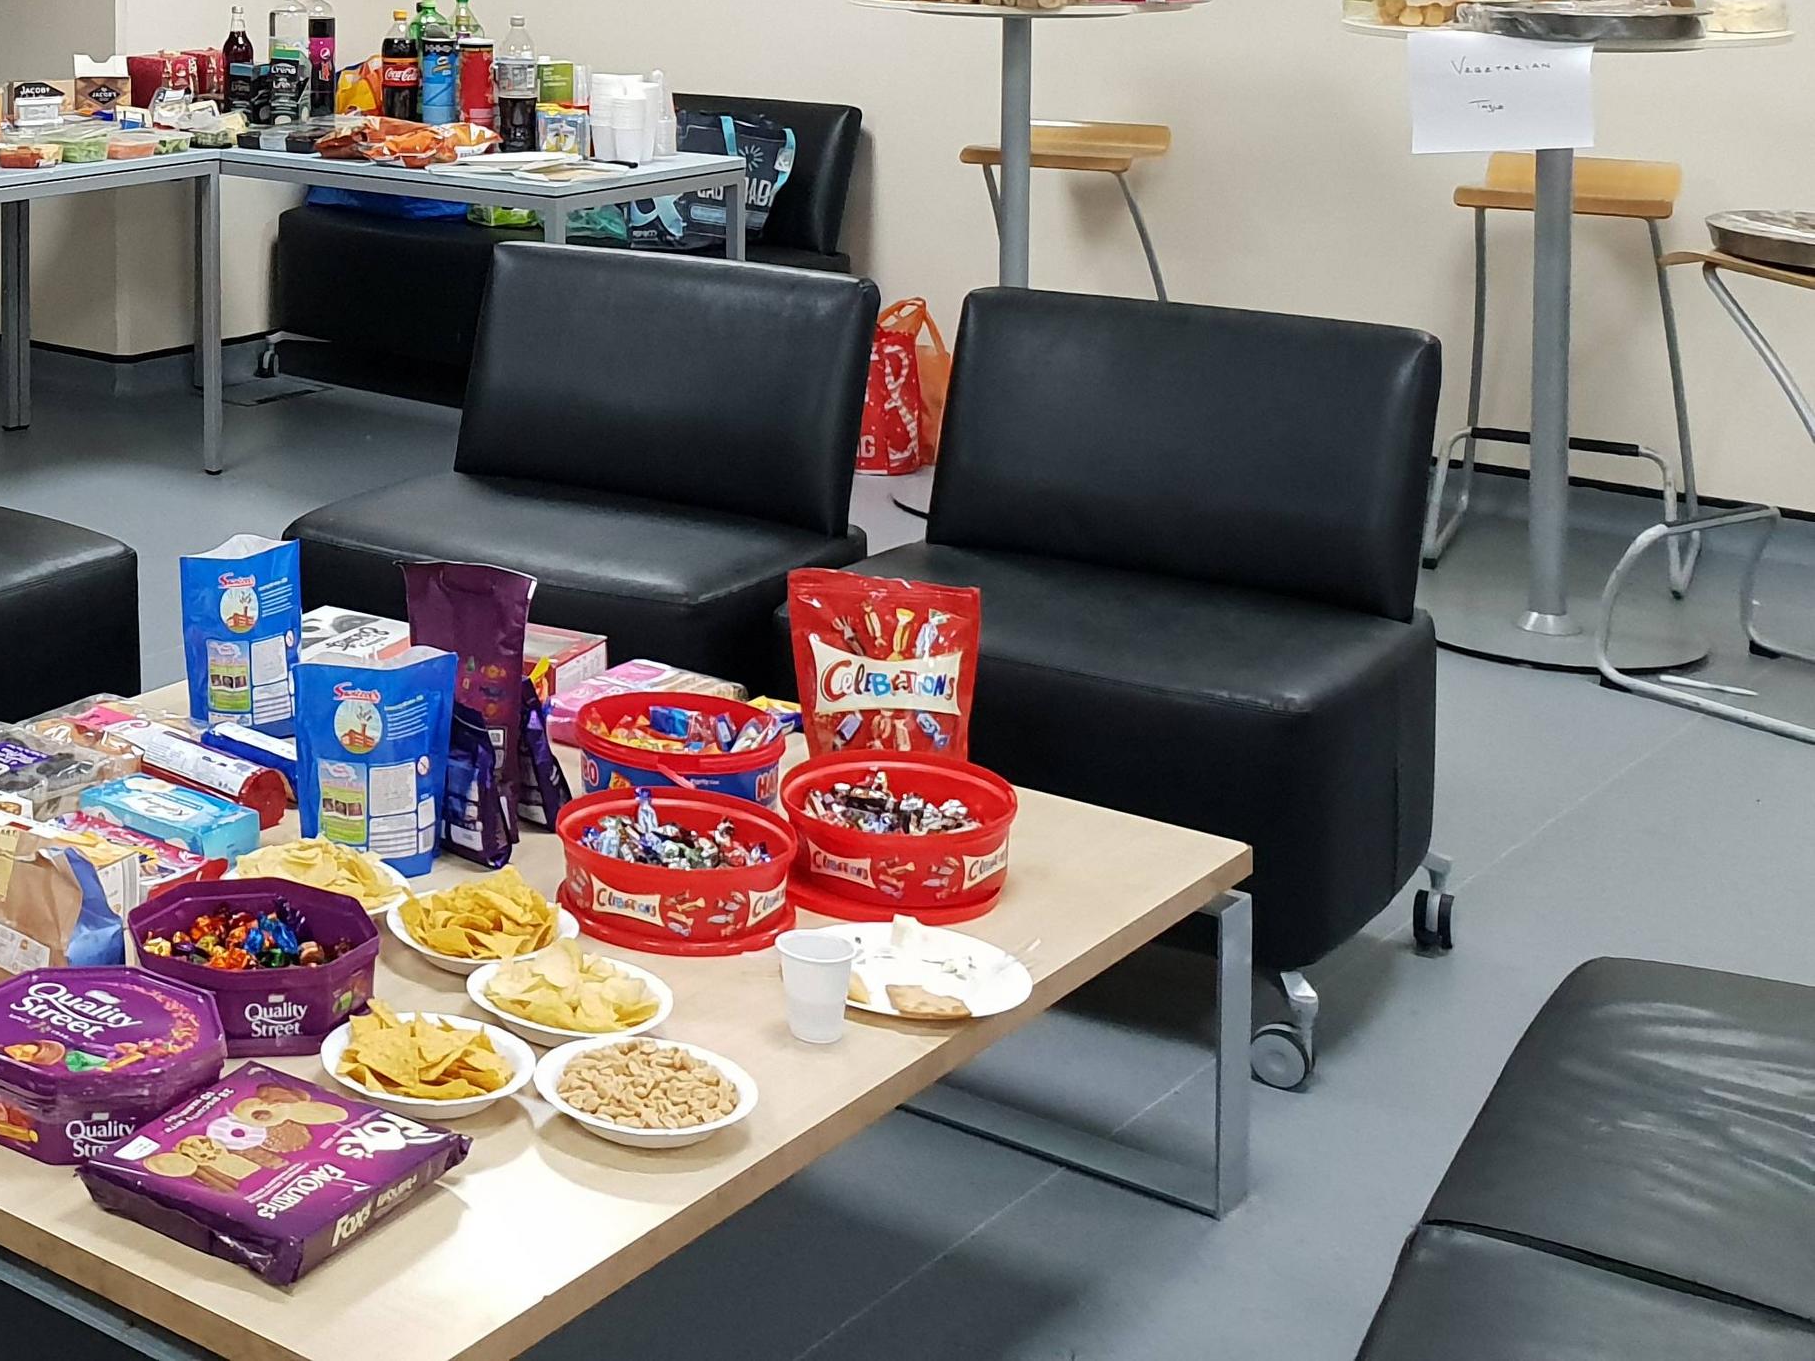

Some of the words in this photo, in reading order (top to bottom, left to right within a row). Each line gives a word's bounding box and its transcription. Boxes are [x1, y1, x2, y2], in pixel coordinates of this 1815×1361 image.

[28, 982, 144, 1028] Quality
[244, 1001, 308, 1025] Quality
[10, 996, 105, 1041] Street
[251, 1021, 300, 1037] Street
[65, 1119, 135, 1144] Quality
[73, 1140, 108, 1157] Str
